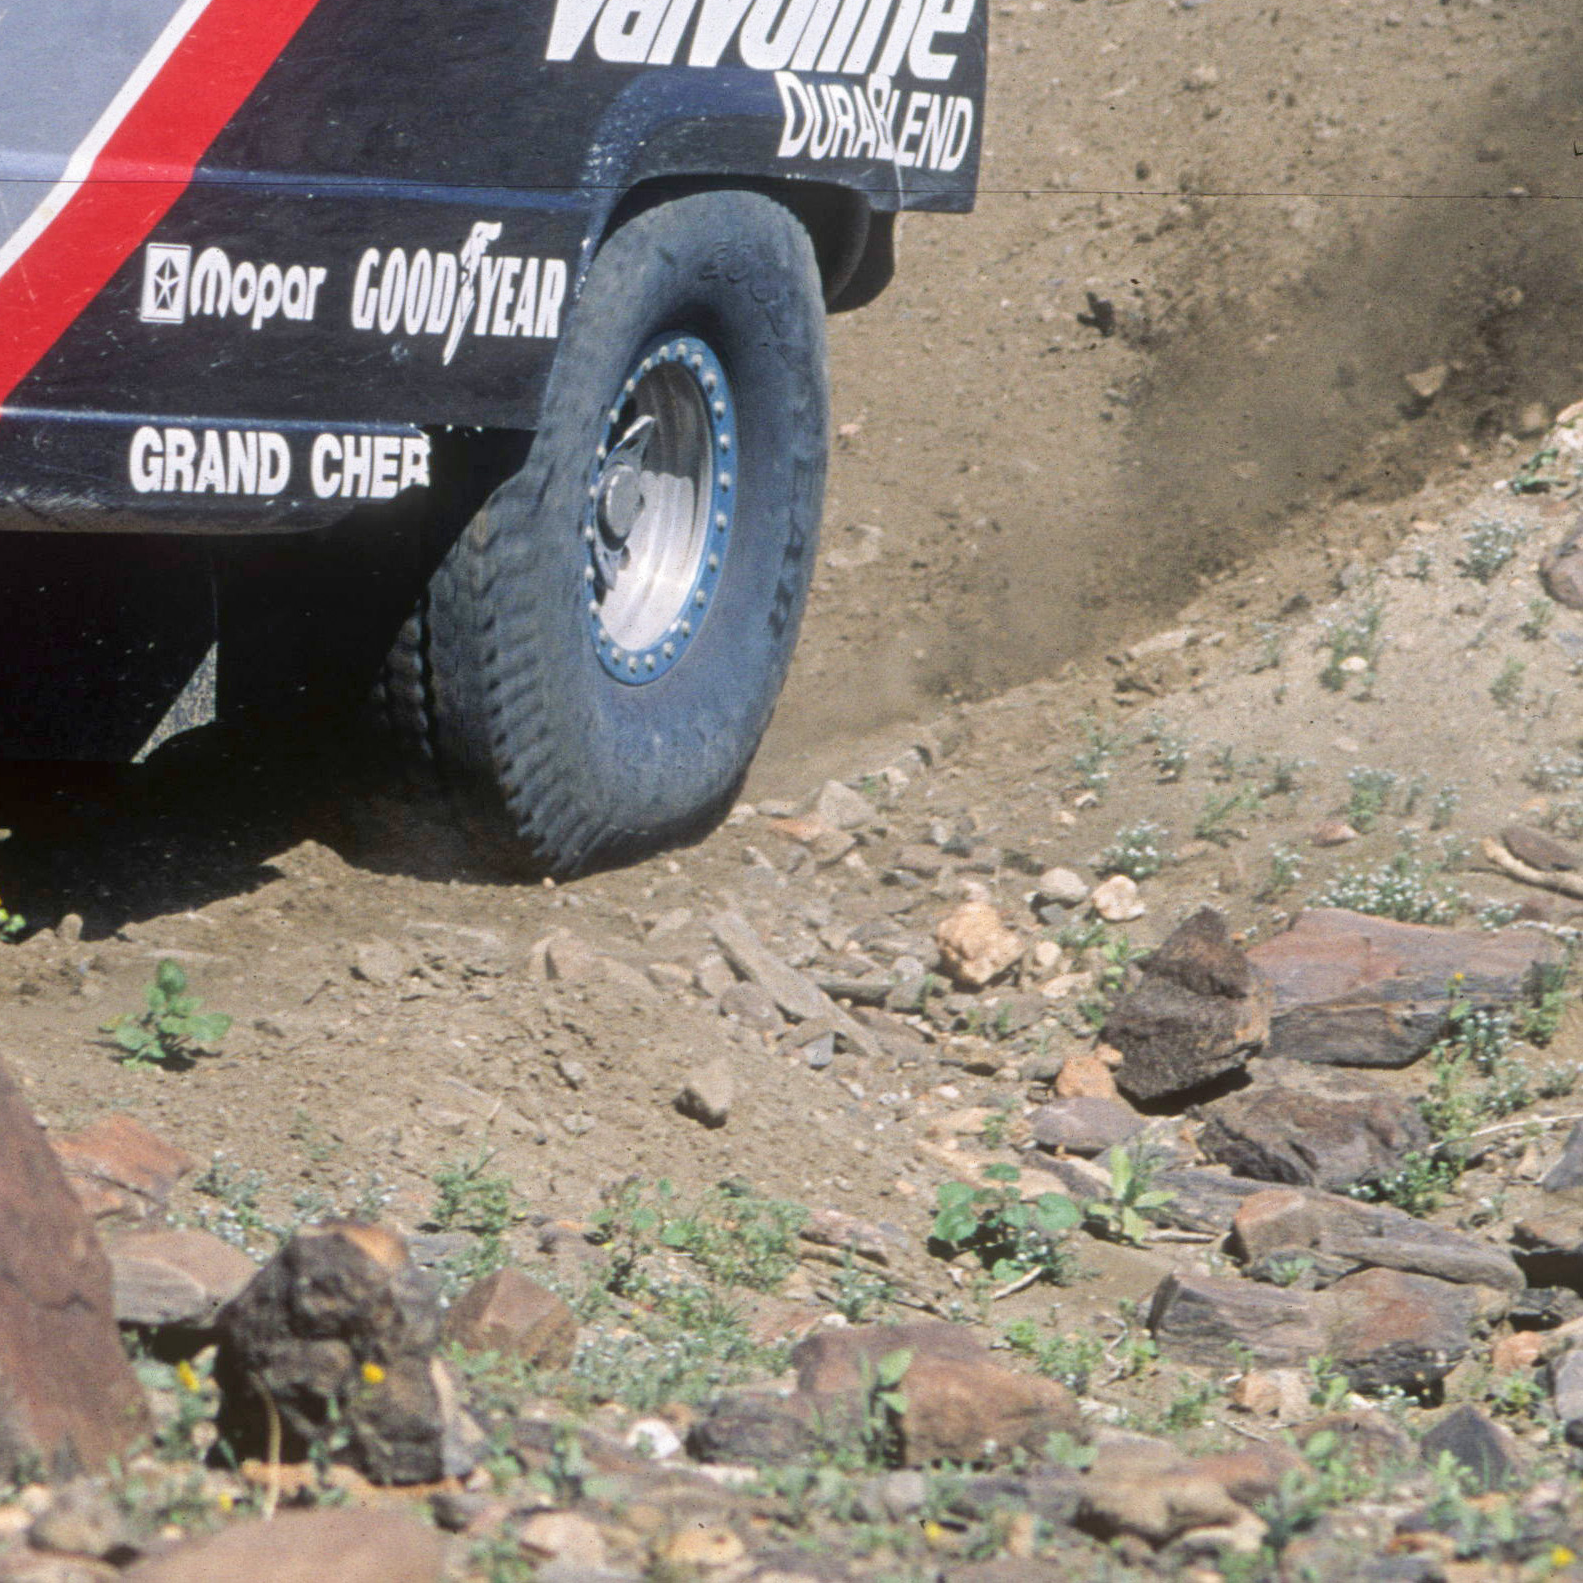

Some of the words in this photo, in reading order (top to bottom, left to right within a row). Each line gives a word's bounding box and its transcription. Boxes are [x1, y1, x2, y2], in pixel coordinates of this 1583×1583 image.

[190, 246, 327, 331] Mopar
[351, 243, 567, 341] GOODYEAR
[130, 425, 291, 495] GRAND
